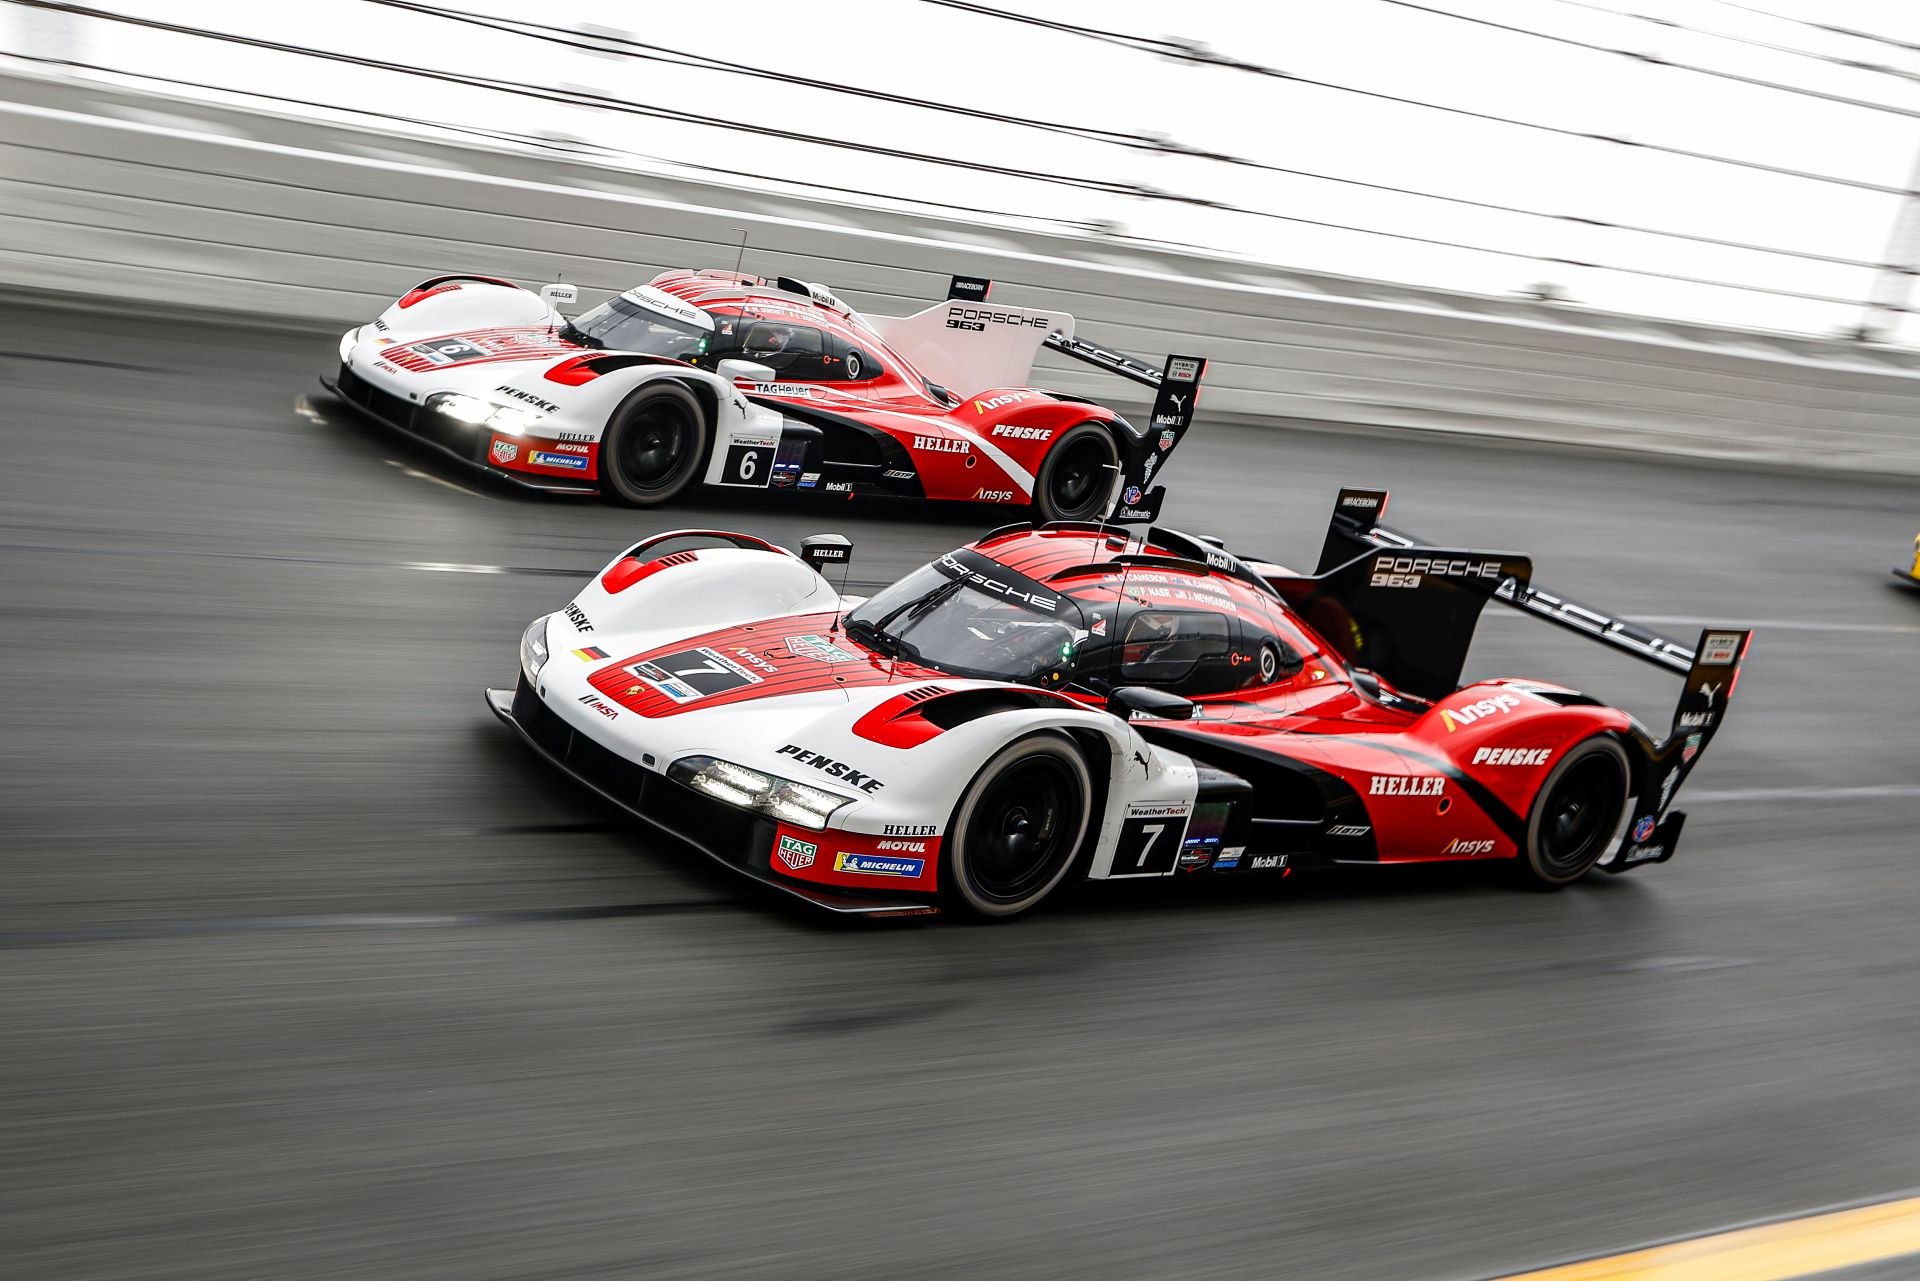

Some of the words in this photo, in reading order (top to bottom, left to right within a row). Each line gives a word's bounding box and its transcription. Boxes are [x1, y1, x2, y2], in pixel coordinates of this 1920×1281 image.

[550, 291, 573, 299] HELLER
[813, 292, 829, 304] Mobil
[946, 319, 986, 332] 963
[948, 307, 1049, 329] PORSCHE
[1174, 361, 1195, 369] HYBRID
[495, 385, 561, 414] PENSKE
[974, 392, 1031, 415] Ansys
[1156, 414, 1175, 425] Mobil
[558, 432, 596, 442] HELLER
[992, 424, 1053, 441] PENSKE
[496, 442, 516, 453] TAG
[556, 443, 589, 453] MOTUL
[733, 439, 775, 447] WeatherTech
[913, 435, 971, 454] HELLER
[493, 449, 516, 462] HEUER
[545, 456, 583, 466] MICHELIN
[739, 450, 758, 480] 6
[826, 482, 846, 492] Mobil
[971, 487, 1013, 503] Ansys
[813, 549, 844, 558] HELLER
[1206, 552, 1229, 571] Mobil
[1374, 556, 1502, 578] PORSCHE
[1370, 573, 1422, 588] 963
[565, 602, 595, 633] PENSKE
[674, 659, 731, 677] 7
[702, 648, 757, 682] WeatherTech
[728, 647, 778, 673] Ansys
[589, 701, 619, 720] IMSA
[1439, 693, 1521, 733] Ansys
[1472, 747, 1553, 766] PENSKE
[775, 744, 885, 794] PENSKE
[1369, 775, 1446, 796] HELLER
[1131, 807, 1187, 816] WeatherTech
[883, 824, 937, 836] HELLER
[784, 838, 813, 855] TAG
[877, 840, 926, 853] MOTUL
[1136, 824, 1165, 867] 7
[1441, 838, 1496, 856] Ansys
[780, 849, 813, 869] HEUER
[861, 861, 916, 872] MICHELIN
[1251, 857, 1277, 869] Mobil
